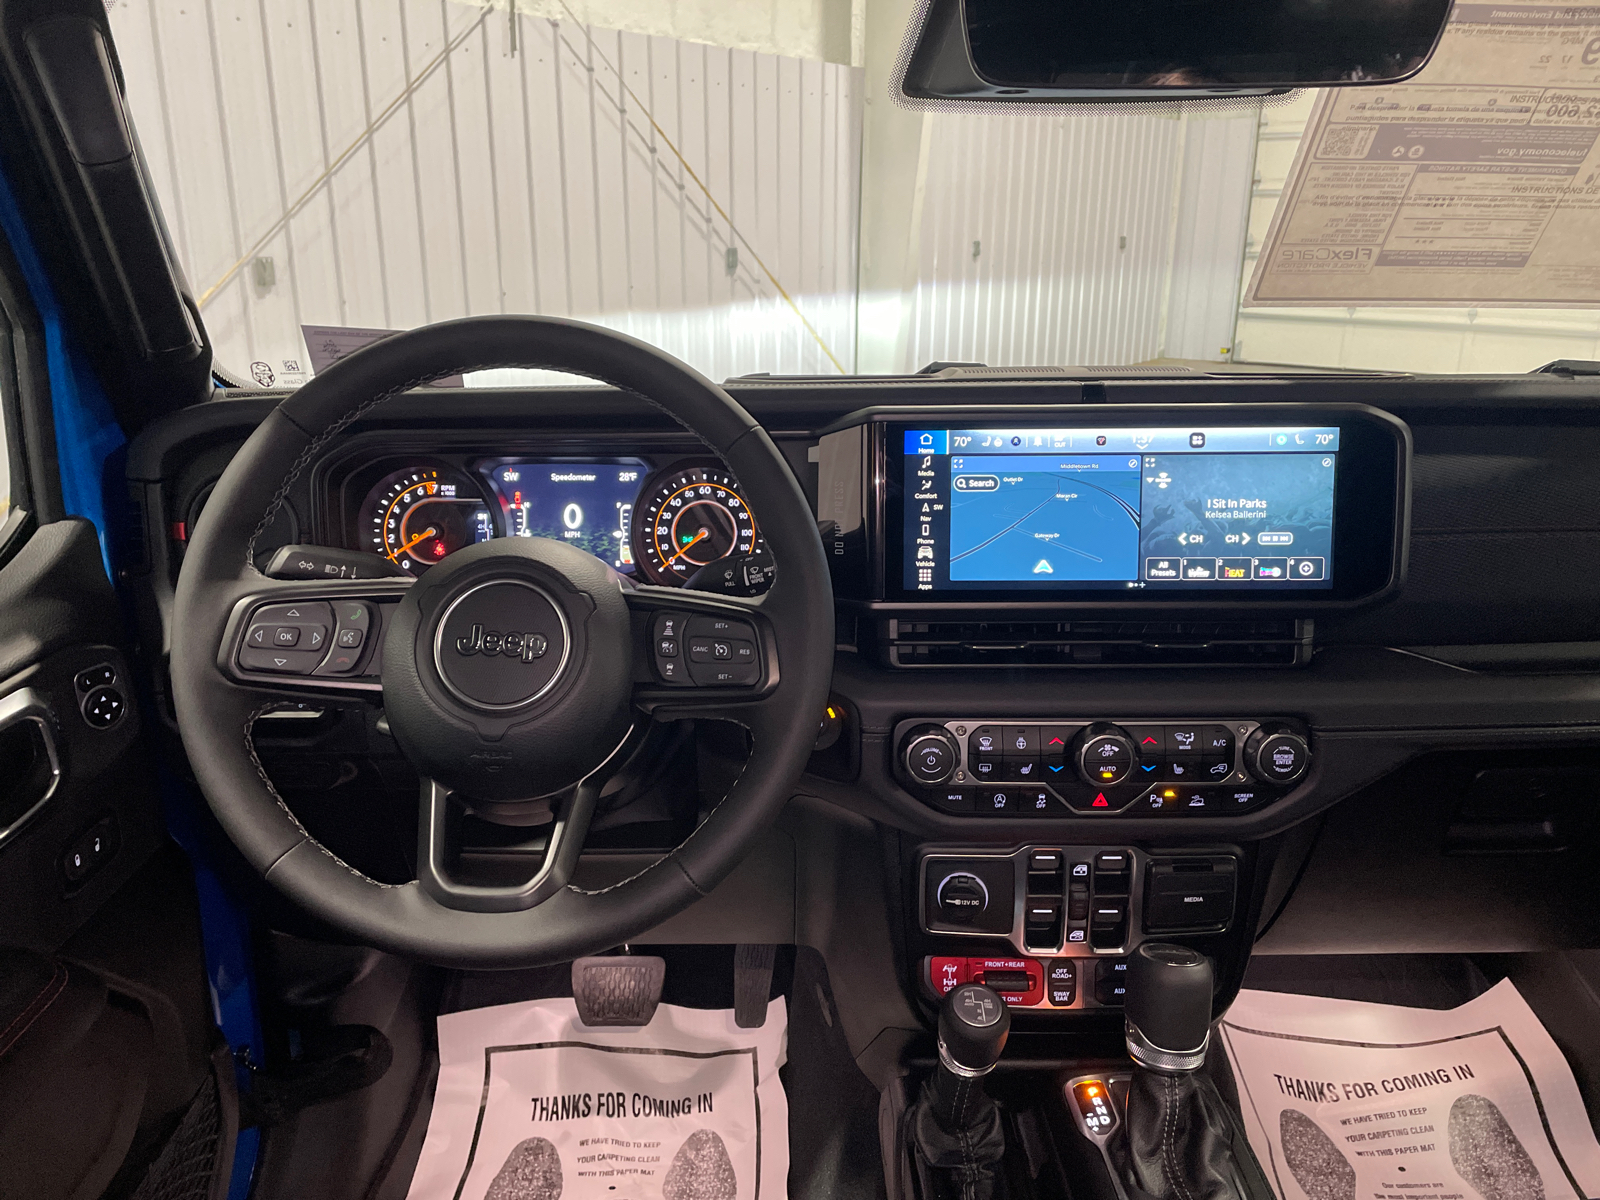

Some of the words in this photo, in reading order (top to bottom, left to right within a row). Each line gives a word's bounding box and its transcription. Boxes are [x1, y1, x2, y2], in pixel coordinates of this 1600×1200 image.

[1511, 186, 1583, 194] INSTRUCTIONS
[1315, 434, 1334, 444] 70°
[504, 473, 519, 481] SW
[551, 473, 596, 482] Speedometer
[968, 479, 994, 488] Search
[417, 487, 424, 496] 6
[404, 494, 410, 503] 5
[834, 481, 844, 513] PRESS
[1213, 499, 1226, 508] Sit
[1228, 499, 1237, 508] In
[1239, 499, 1266, 508] Parks
[393, 506, 400, 514] 4
[1233, 510, 1266, 519] Ballerini
[563, 503, 582, 529] 0
[388, 519, 395, 528] 3
[388, 534, 395, 543] 2
[834, 541, 844, 555] DO
[402, 560, 410, 569] 0
[1224, 567, 1245, 577] HEAT
[456, 623, 549, 664] Jeep
[1273, 1073, 1340, 1104] THANKS
[1342, 1080, 1379, 1101] FOR
[1382, 1068, 1452, 1094] COMING
[1452, 1063, 1476, 1080] IN
[530, 1094, 591, 1122] THANKS
[597, 1092, 626, 1118] FOR
[632, 1094, 692, 1118] COMING
[698, 1092, 713, 1113] IN
[1096, 1107, 1108, 1115] N
[1100, 1117, 1110, 1125] D
[1340, 1118, 1352, 1126] WE
[1353, 1114, 1372, 1124] HAVE
[1373, 1110, 1396, 1121] TRIED
[1397, 1109, 1407, 1118] TO
[1408, 1107, 1428, 1116] KEEP
[1086, 1118, 1099, 1127] M
[1345, 1133, 1366, 1143] YOUR
[1367, 1128, 1408, 1140] CARPETING
[1410, 1125, 1434, 1135] CLEAN
[591, 1138, 609, 1146] HAVE
[611, 1138, 631, 1148] TRIED
[1355, 1149, 1375, 1158] WITH
[1376, 1148, 1393, 1156] THIS
[1394, 1145, 1419, 1155] PAPER
[1420, 1144, 1435, 1152] MAT
[577, 1155, 595, 1164] YOUR
[598, 1169, 615, 1177] THIS
